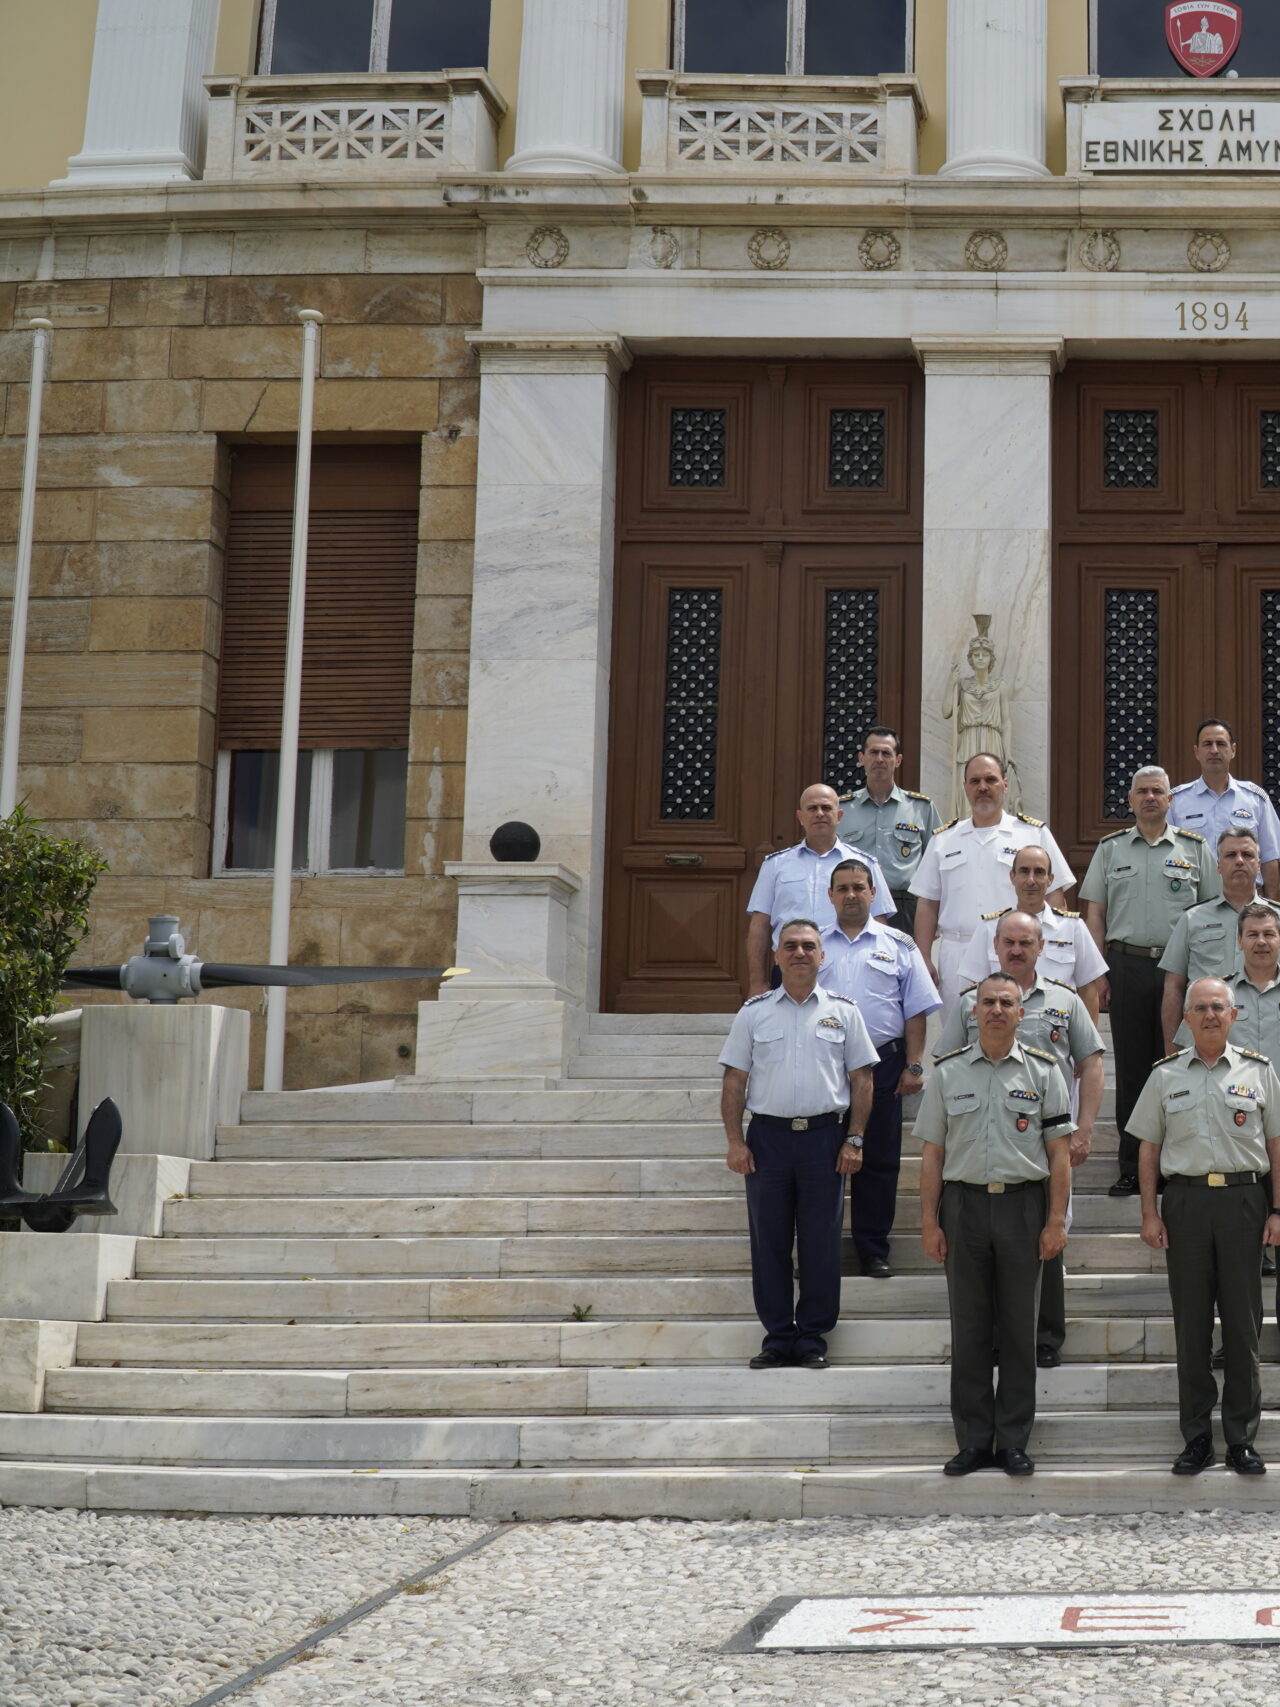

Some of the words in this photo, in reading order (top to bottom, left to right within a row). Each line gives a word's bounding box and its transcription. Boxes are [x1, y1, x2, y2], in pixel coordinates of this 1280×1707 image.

[1158, 108, 1255, 132] ΣΧΟΛΗ
[1085, 139, 1204, 163] ΕΘΝΙΚΗΣ
[1174, 301, 1249, 331] 1894
